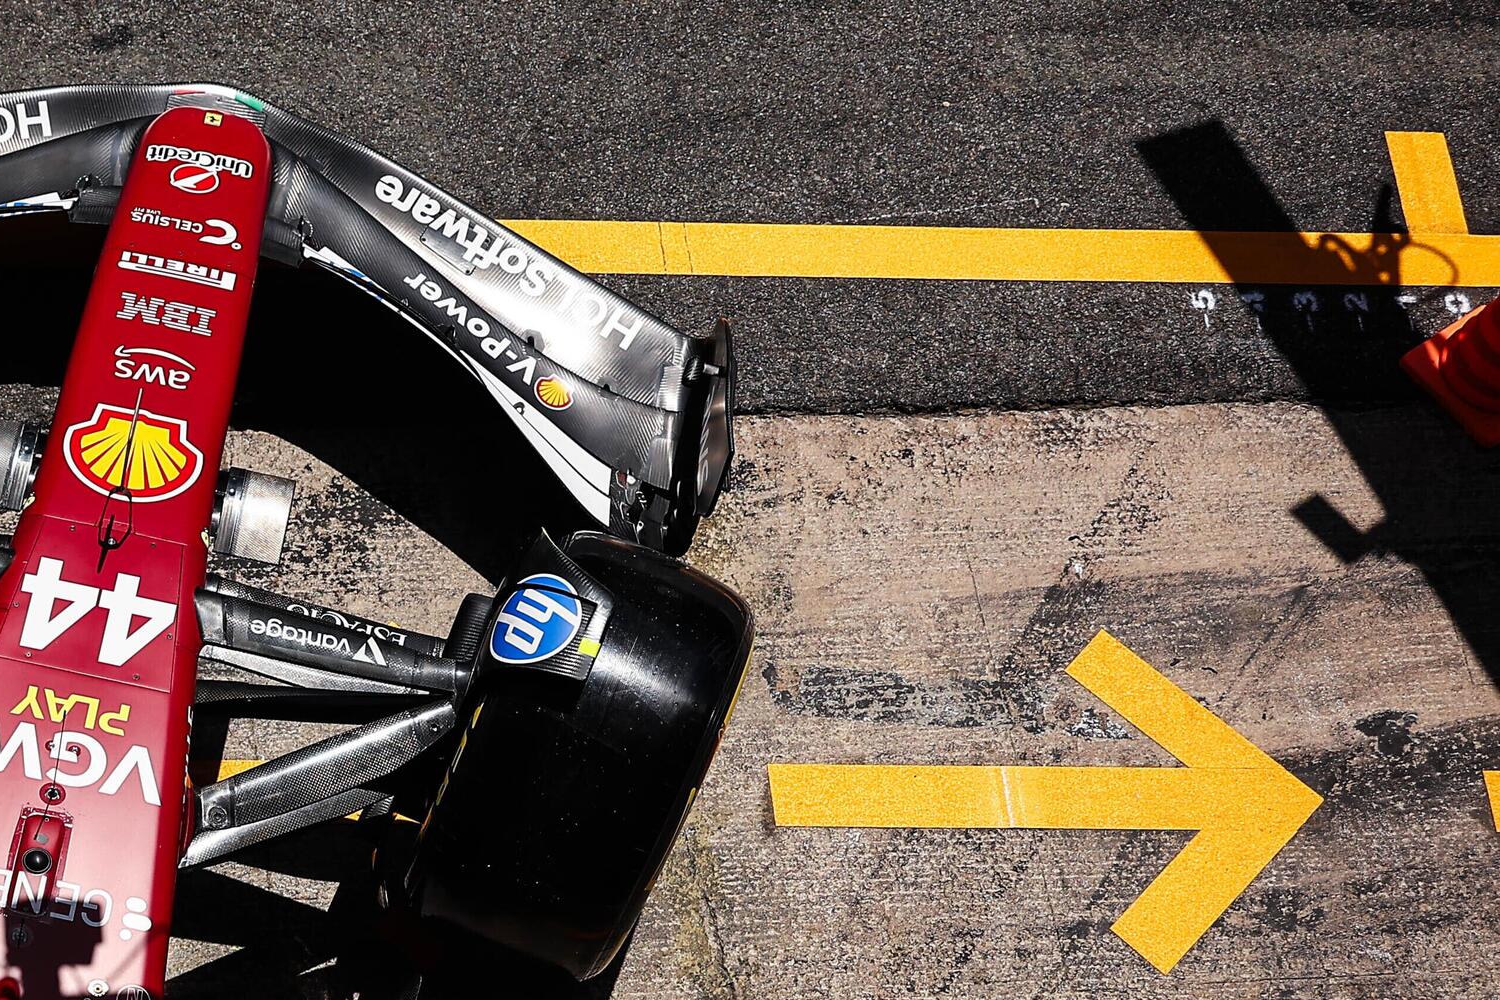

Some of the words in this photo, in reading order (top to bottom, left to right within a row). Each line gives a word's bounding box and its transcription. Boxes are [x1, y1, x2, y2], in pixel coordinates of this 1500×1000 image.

[146, 145, 253, 178] UniCredit
[131, 211, 203, 233] CELSIUS
[118, 250, 236, 291] PIRELLI
[374, 174, 644, 351] HCLSoftware
[116, 291, 216, 336] IBM
[403, 272, 538, 386] V-Power
[114, 357, 192, 390] aws
[20, 557, 177, 667] 44
[493, 576, 578, 662] hp
[248, 619, 351, 655] vantage
[11, 685, 131, 737] PLAY
